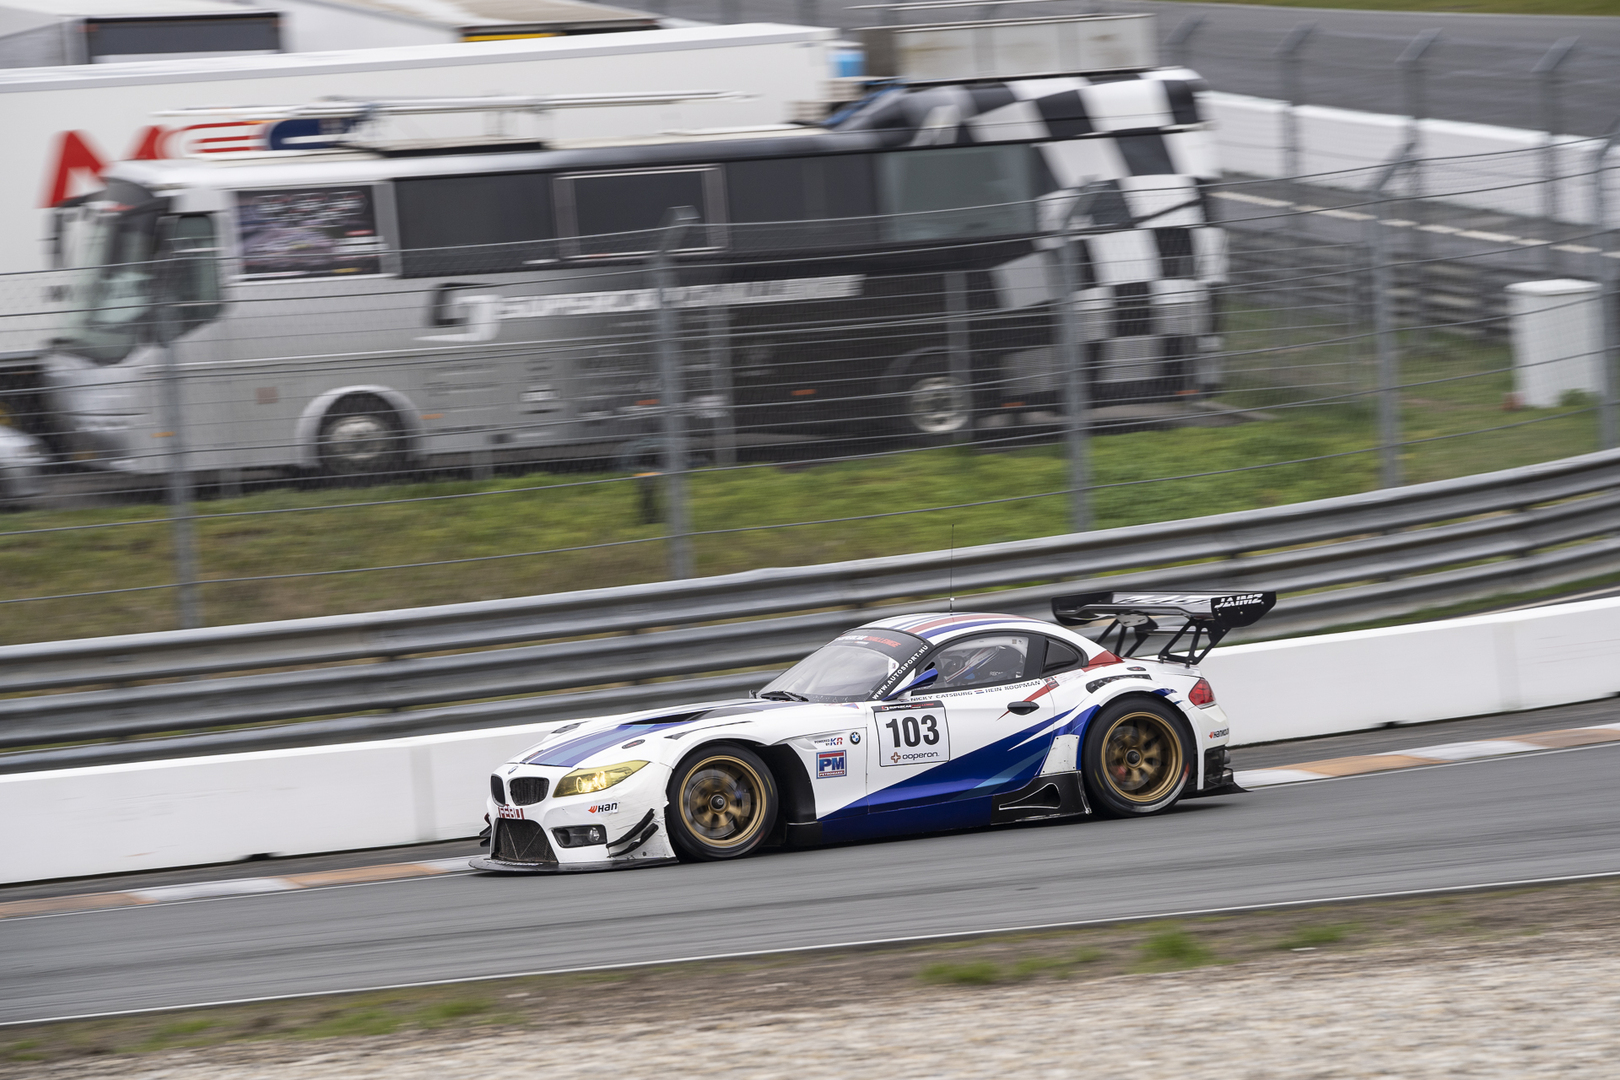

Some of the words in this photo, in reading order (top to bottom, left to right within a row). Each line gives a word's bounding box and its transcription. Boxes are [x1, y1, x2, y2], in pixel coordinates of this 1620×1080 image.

[1004, 680, 1041, 690] KOOPMAN
[885, 714, 940, 748] 103
[819, 756, 845, 772] PM
[597, 802, 618, 813] Han
